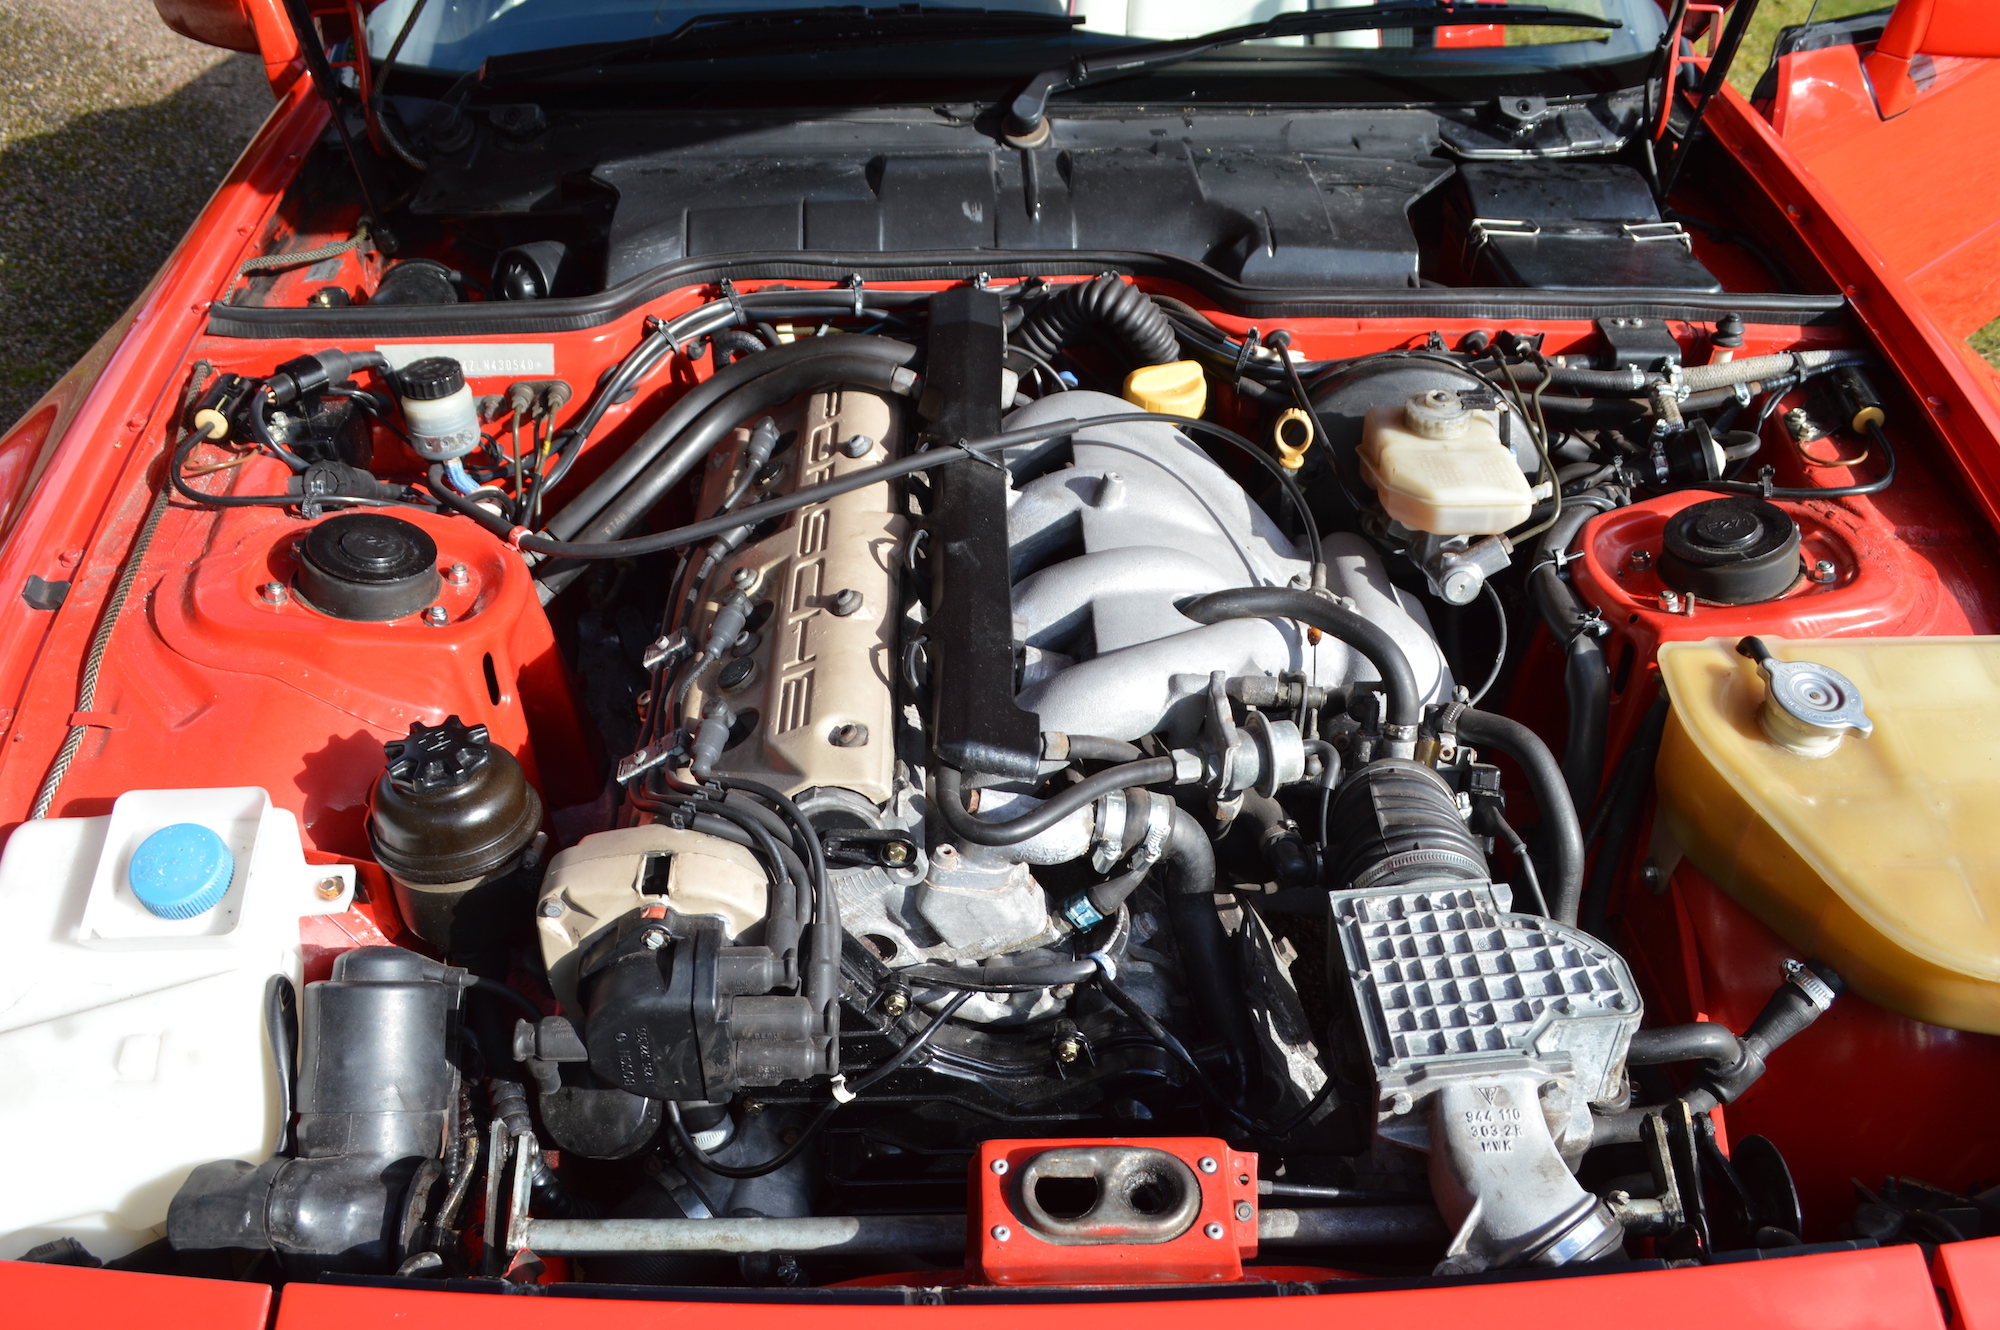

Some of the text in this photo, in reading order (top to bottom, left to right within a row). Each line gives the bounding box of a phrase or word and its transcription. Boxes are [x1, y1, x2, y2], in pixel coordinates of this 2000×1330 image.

[775, 391, 841, 736] PORSCHE
[618, 1050, 636, 1086] BOSCH
[1465, 1108, 1521, 1123] 944 110
[1481, 1140, 1512, 1152] MWK
